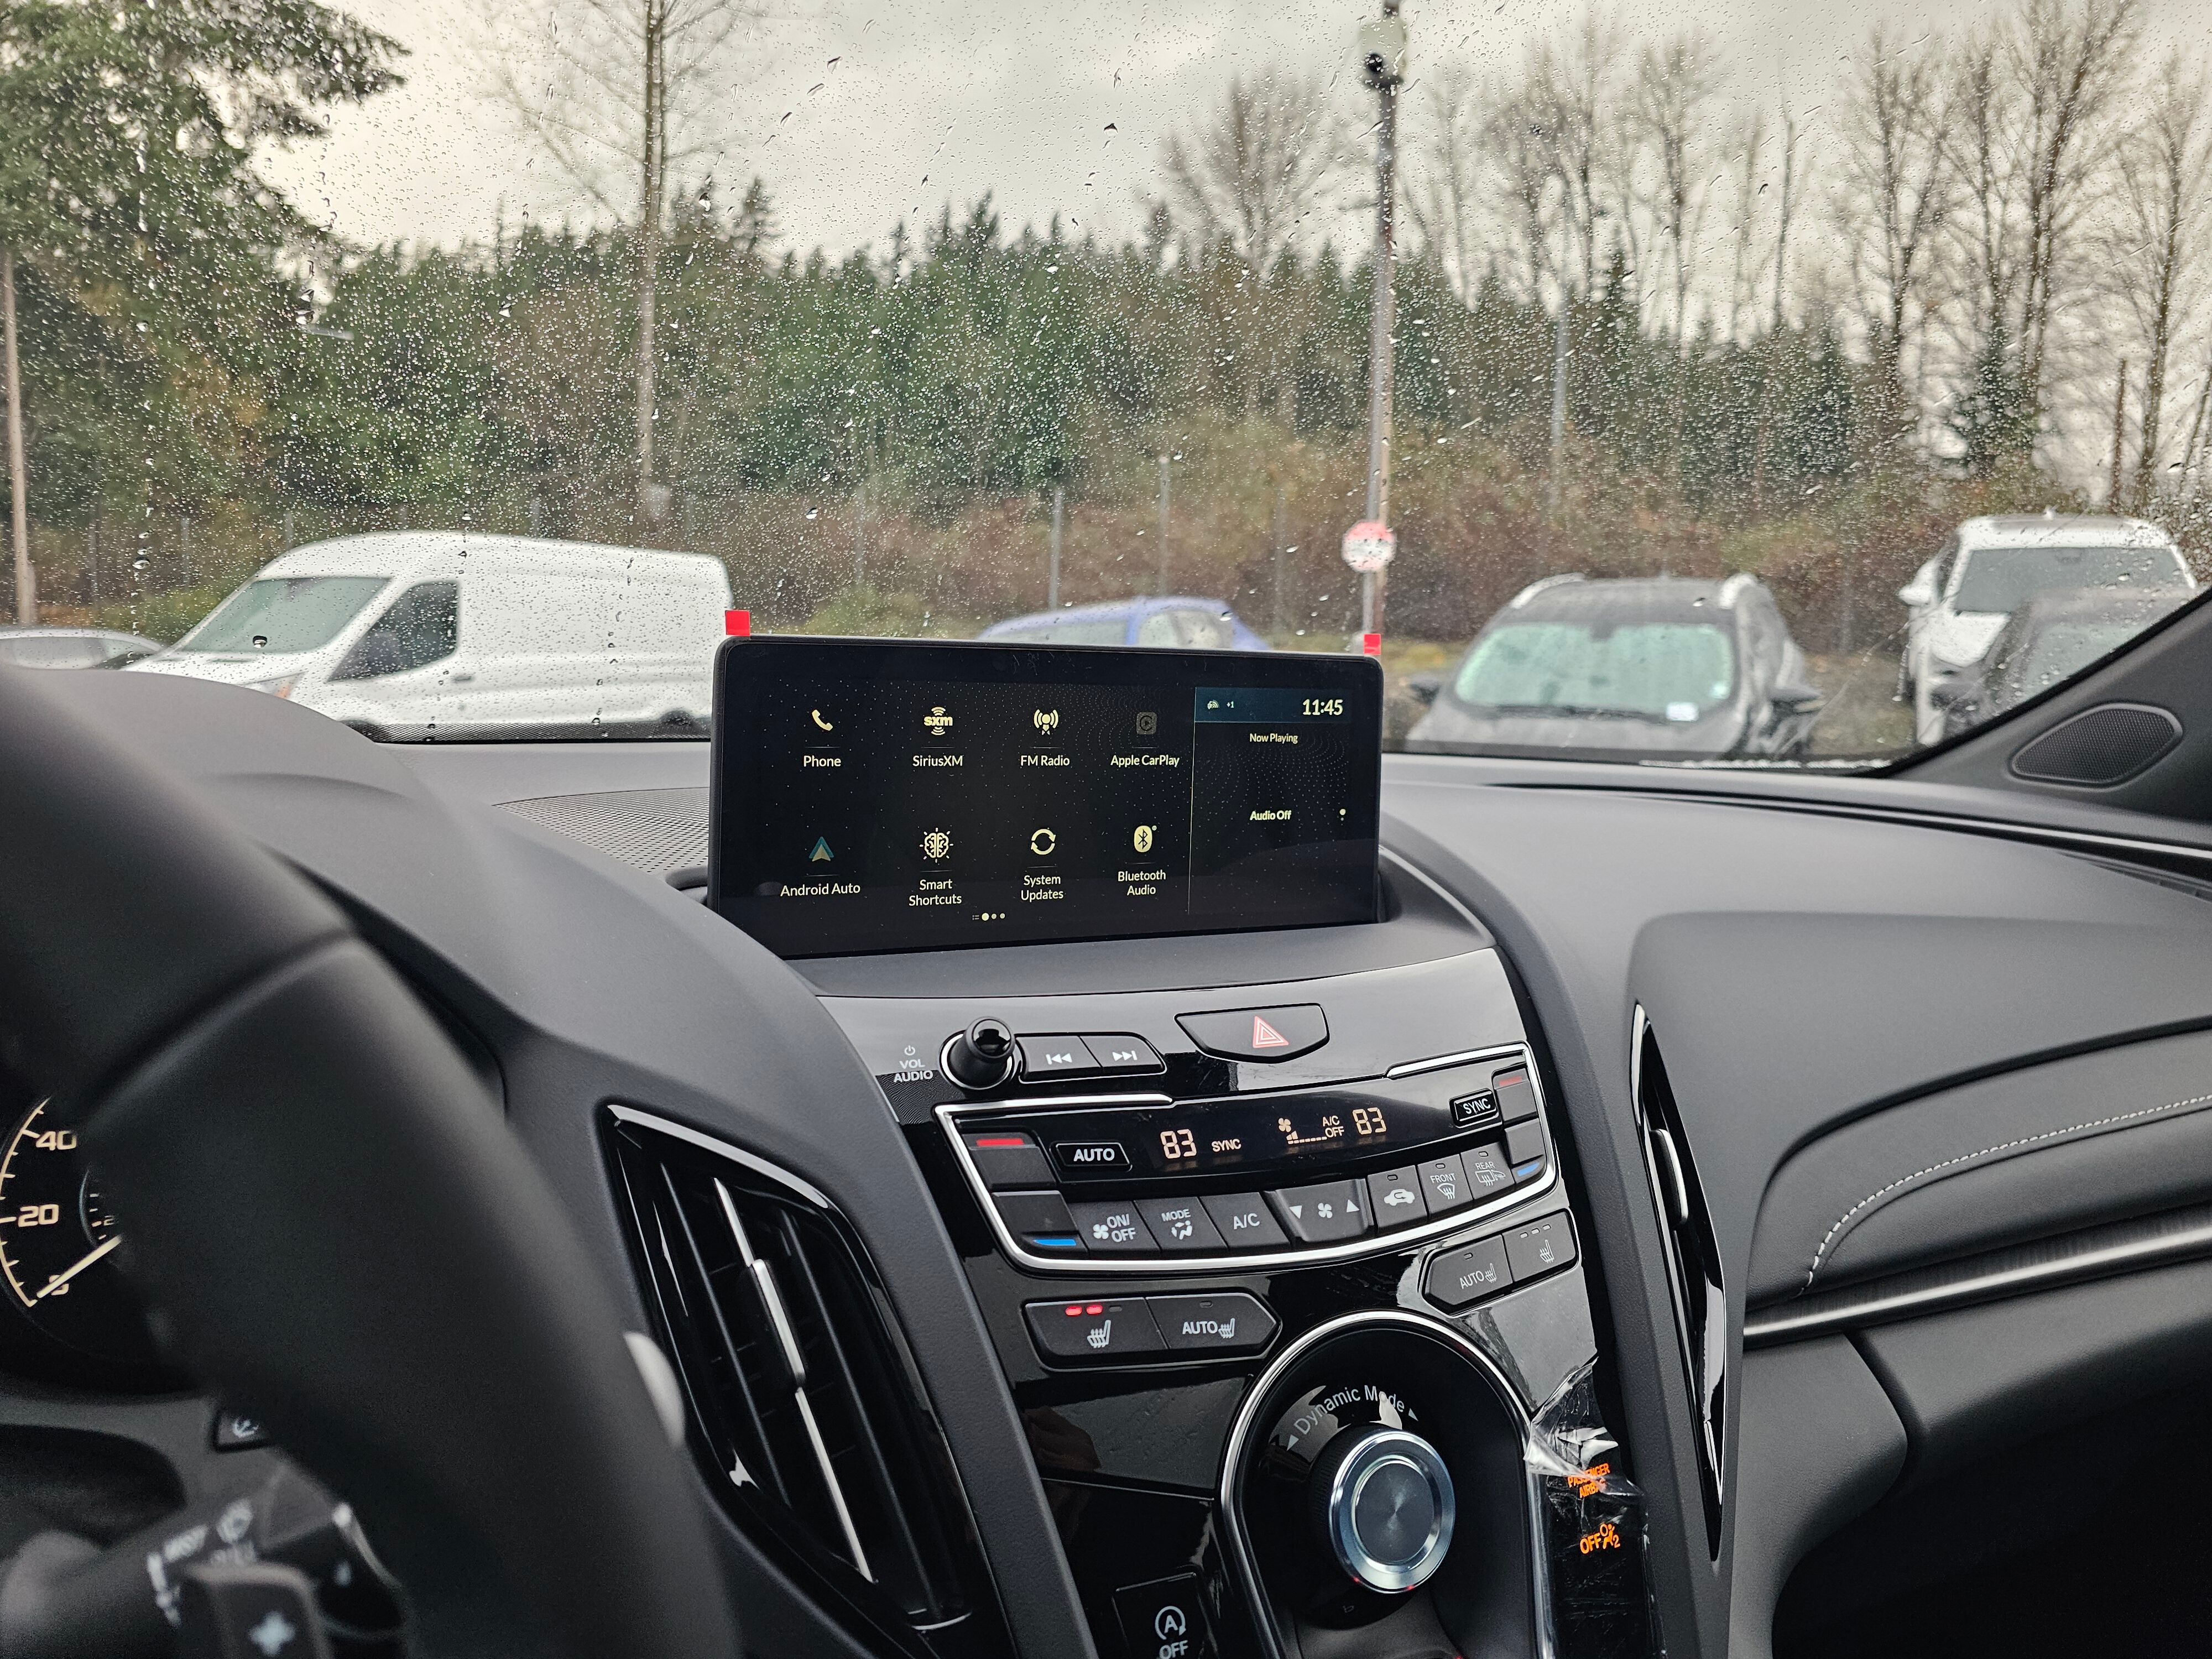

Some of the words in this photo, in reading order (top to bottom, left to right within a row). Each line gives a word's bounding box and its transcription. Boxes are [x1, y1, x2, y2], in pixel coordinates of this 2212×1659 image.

[1302, 698, 1343, 716] 11:45
[1250, 733, 1269, 742] Now
[1270, 733, 1298, 744] Playing
[804, 755, 842, 767] Phone
[912, 755, 963, 766] SiriusXM
[1020, 755, 1038, 766] FM
[1041, 754, 1070, 766] Radio
[1110, 754, 1140, 768] Apple
[1141, 754, 1180, 768] CarPlay
[1249, 810, 1276, 821] Audio
[1276, 810, 1292, 820] Off
[1023, 875, 1061, 888] System
[1118, 869, 1166, 881] Bluetooth
[780, 883, 829, 897] Android
[831, 883, 860, 895] Auto
[919, 879, 953, 890] Smart
[1126, 884, 1156, 896] Audio
[909, 894, 962, 906] Shortcuts
[1021, 889, 1063, 902] Updates
[899, 1058, 926, 1070] VOL
[894, 1070, 933, 1083] AUDIO
[1463, 1098, 1491, 1115] SYNC
[1322, 1115, 1340, 1127] A/C
[1352, 1107, 1387, 1135] 83
[1325, 1125, 1345, 1138] OFF
[36, 1131, 77, 1151] 40
[1160, 1129, 1197, 1159] 83
[1211, 1139, 1241, 1152] SYNC
[1073, 1148, 1115, 1162] AUTO
[1475, 1162, 1495, 1170] REAR
[1430, 1173, 1456, 1185] FRONT
[18, 1204, 59, 1227] 20
[1107, 1214, 1130, 1228] ON/
[1161, 1209, 1191, 1222] MODE
[1233, 1213, 1260, 1230] A/C
[1111, 1227, 1136, 1243] OFF
[1459, 1270, 1485, 1289] AUTO
[1182, 1321, 1218, 1334] AUTO
[1293, 1387, 1360, 1434] Dynamic
[1364, 1385, 1405, 1412] Mode
[1580, 1532, 1601, 1554] OFF
[1159, 1640, 1189, 1659] OFF
